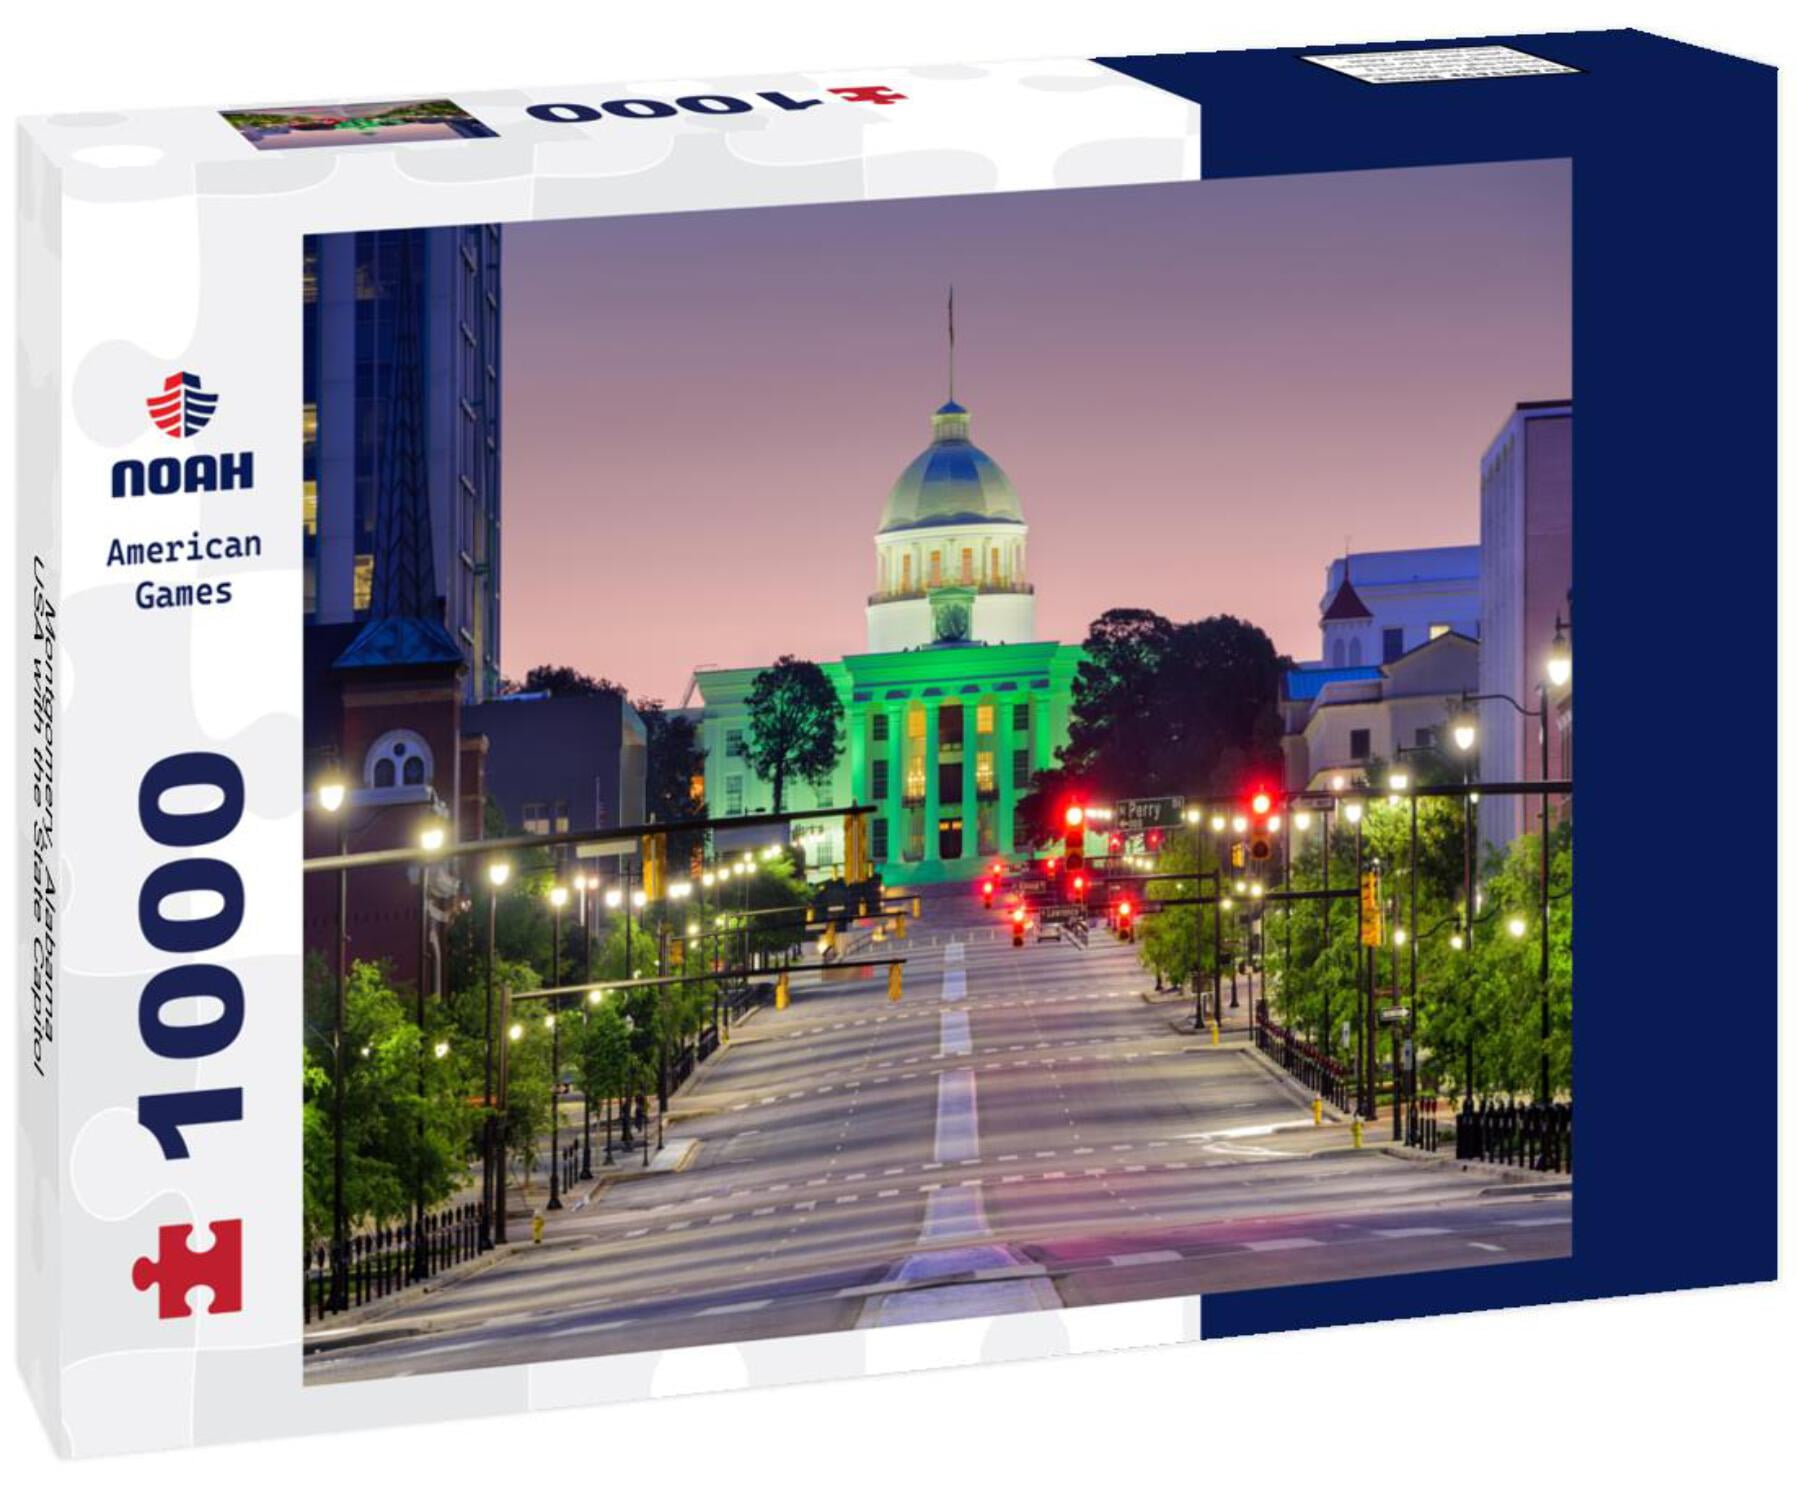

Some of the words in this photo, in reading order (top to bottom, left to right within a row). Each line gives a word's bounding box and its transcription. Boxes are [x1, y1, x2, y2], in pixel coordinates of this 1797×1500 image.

[527, 91, 823, 123] 1000
[111, 451, 254, 498] NOAH
[106, 531, 261, 567] American
[33, 555, 45, 640] USA
[135, 580, 232, 610] Games
[33, 658, 45, 734] with
[42, 599, 57, 848] Montgomery,
[33, 746, 45, 808] the
[1128, 800, 1161, 822] Perry
[33, 817, 45, 923] State
[44, 865, 57, 1043] Alabama
[138, 751, 245, 1160] 1000
[31, 936, 45, 1077] Capitol
